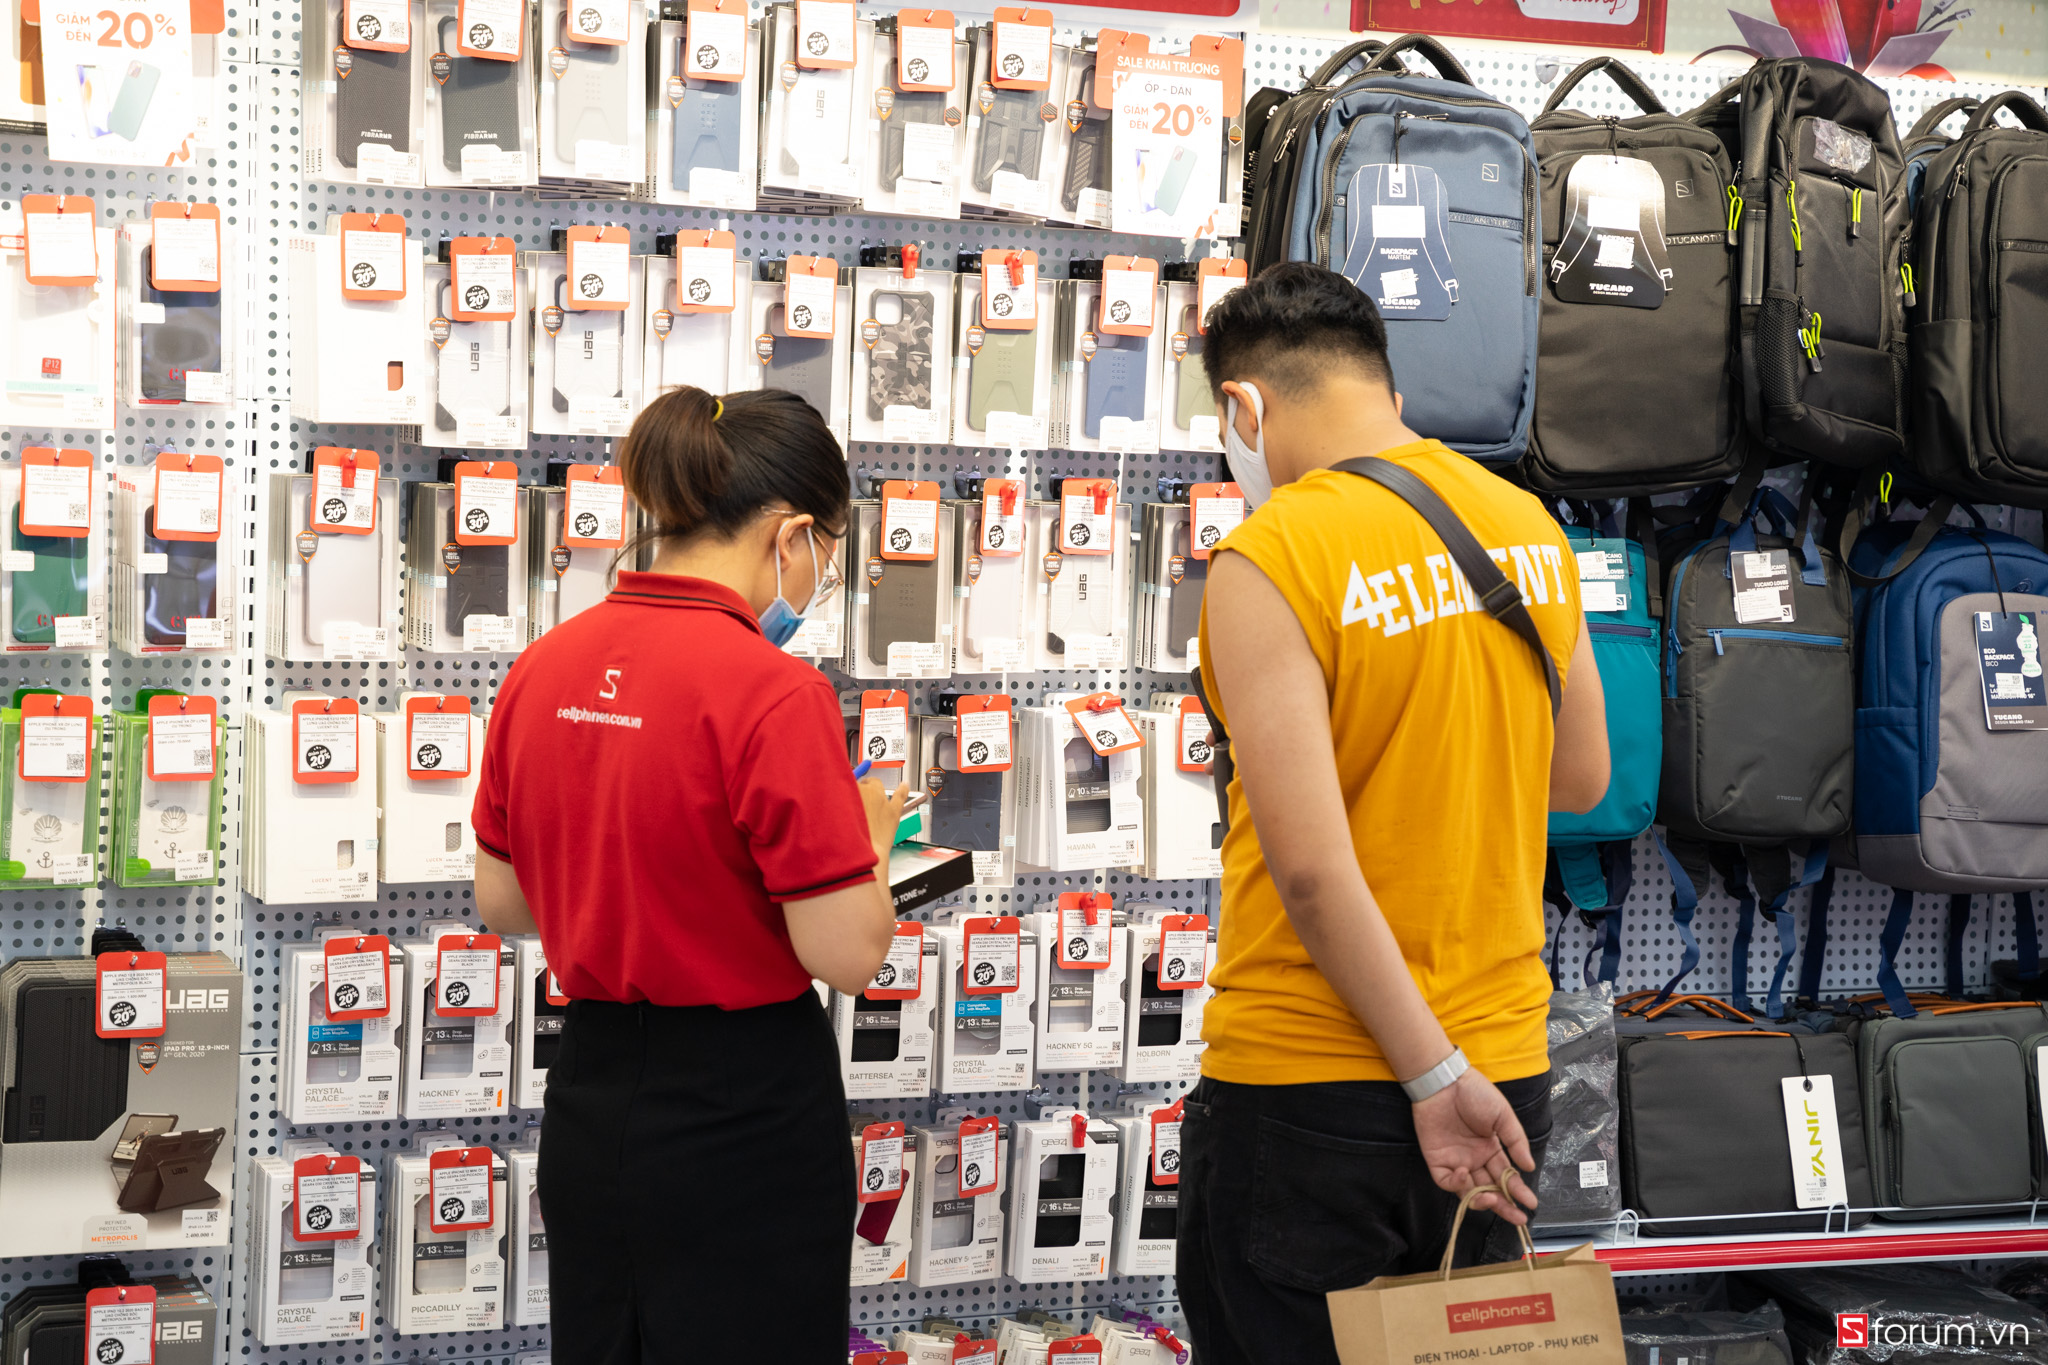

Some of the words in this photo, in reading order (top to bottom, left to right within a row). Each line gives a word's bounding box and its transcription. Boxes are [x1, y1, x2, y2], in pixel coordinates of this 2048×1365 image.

[56, 11, 90, 25] GIẢM
[581, 14, 601, 30] 20%
[66, 28, 91, 42] ĐẾN
[96, 10, 176, 49] 20%
[360, 24, 381, 39] 20%
[473, 29, 494, 46] 20%
[809, 38, 829, 53] 30%
[909, 64, 929, 79] 20%
[1005, 58, 1024, 75] 20%
[1117, 56, 1143, 68] SALE
[1146, 59, 1170, 71] KHAI
[1173, 61, 1220, 75] TRƯƠNG
[1123, 103, 1149, 116] GIẢM
[1129, 118, 1149, 130] ĐẾN
[1152, 102, 1212, 136] 20%
[360, 131, 393, 140] FIBRARMR
[464, 132, 498, 140] FIBRARMR
[1596, 234, 1635, 243] BACKPACK
[1380, 248, 1418, 256] BACKPACK
[356, 270, 376, 286] 20%
[584, 280, 604, 297] 20%
[691, 284, 711, 301] 20%
[1589, 283, 1634, 292] TUCANO
[467, 291, 489, 309] 20%
[1378, 298, 1421, 306] TUCANO
[1112, 306, 1131, 322] 20%
[326, 506, 347, 521] 20%
[468, 516, 489, 532] 30%
[577, 520, 599, 536] 30%
[892, 534, 912, 549] 20%
[1072, 530, 1090, 544] 25%
[1203, 530, 1220, 547] 20%
[871, 744, 886, 758] 20%
[970, 747, 988, 763] 20%
[1192, 748, 1210, 761] 20%
[310, 752, 331, 767] 20%
[421, 751, 441, 767] 30%
[1067, 842, 1096, 851] HAVANA
[900, 889, 919, 904] TONE
[1071, 945, 1088, 958] 20%
[878, 971, 896, 984] 20%
[977, 970, 995, 983] 20%
[1170, 965, 1185, 978] 20%
[166, 989, 229, 1009] UAG
[339, 990, 359, 1006] 20%
[449, 990, 469, 1004] 20%
[113, 1009, 136, 1025] 20%
[1046, 1043, 1081, 1051] HACKNEY
[1082, 1042, 1093, 1050] 5G
[1136, 1050, 1171, 1059] HOLBORN
[953, 1060, 986, 1068] CRYSTAL
[953, 1066, 982, 1074] PALACE
[849, 1072, 893, 1081] BATTERSEA
[305, 1088, 344, 1096] CRYSTAL
[419, 1090, 460, 1098] HACKNEY
[1804, 1099, 1826, 1177] JINYA
[1164, 1155, 1179, 1169] 20%
[869, 1174, 883, 1188] 20%
[967, 1170, 980, 1184] 20%
[444, 1205, 463, 1220] 20%
[311, 1212, 331, 1228] 20%
[1137, 1244, 1171, 1252] HOLBORN
[929, 1256, 963, 1266] HACKNEY
[1032, 1257, 1059, 1265] DENALI
[277, 1308, 316, 1316] CRYSTAL
[411, 1304, 461, 1313] PICCADILLY
[277, 1315, 312, 1323] PALACE
[155, 1321, 202, 1341] AG
[101, 1347, 123, 1362] 20%
[1414, 1351, 1441, 1365] ĐIỆN
[1444, 1348, 1480, 1361] THOẠI
[1489, 1341, 1535, 1356] LAPTOP
[1545, 1338, 1569, 1350] PHỤ
[1572, 1333, 1599, 1346] KIỆN
